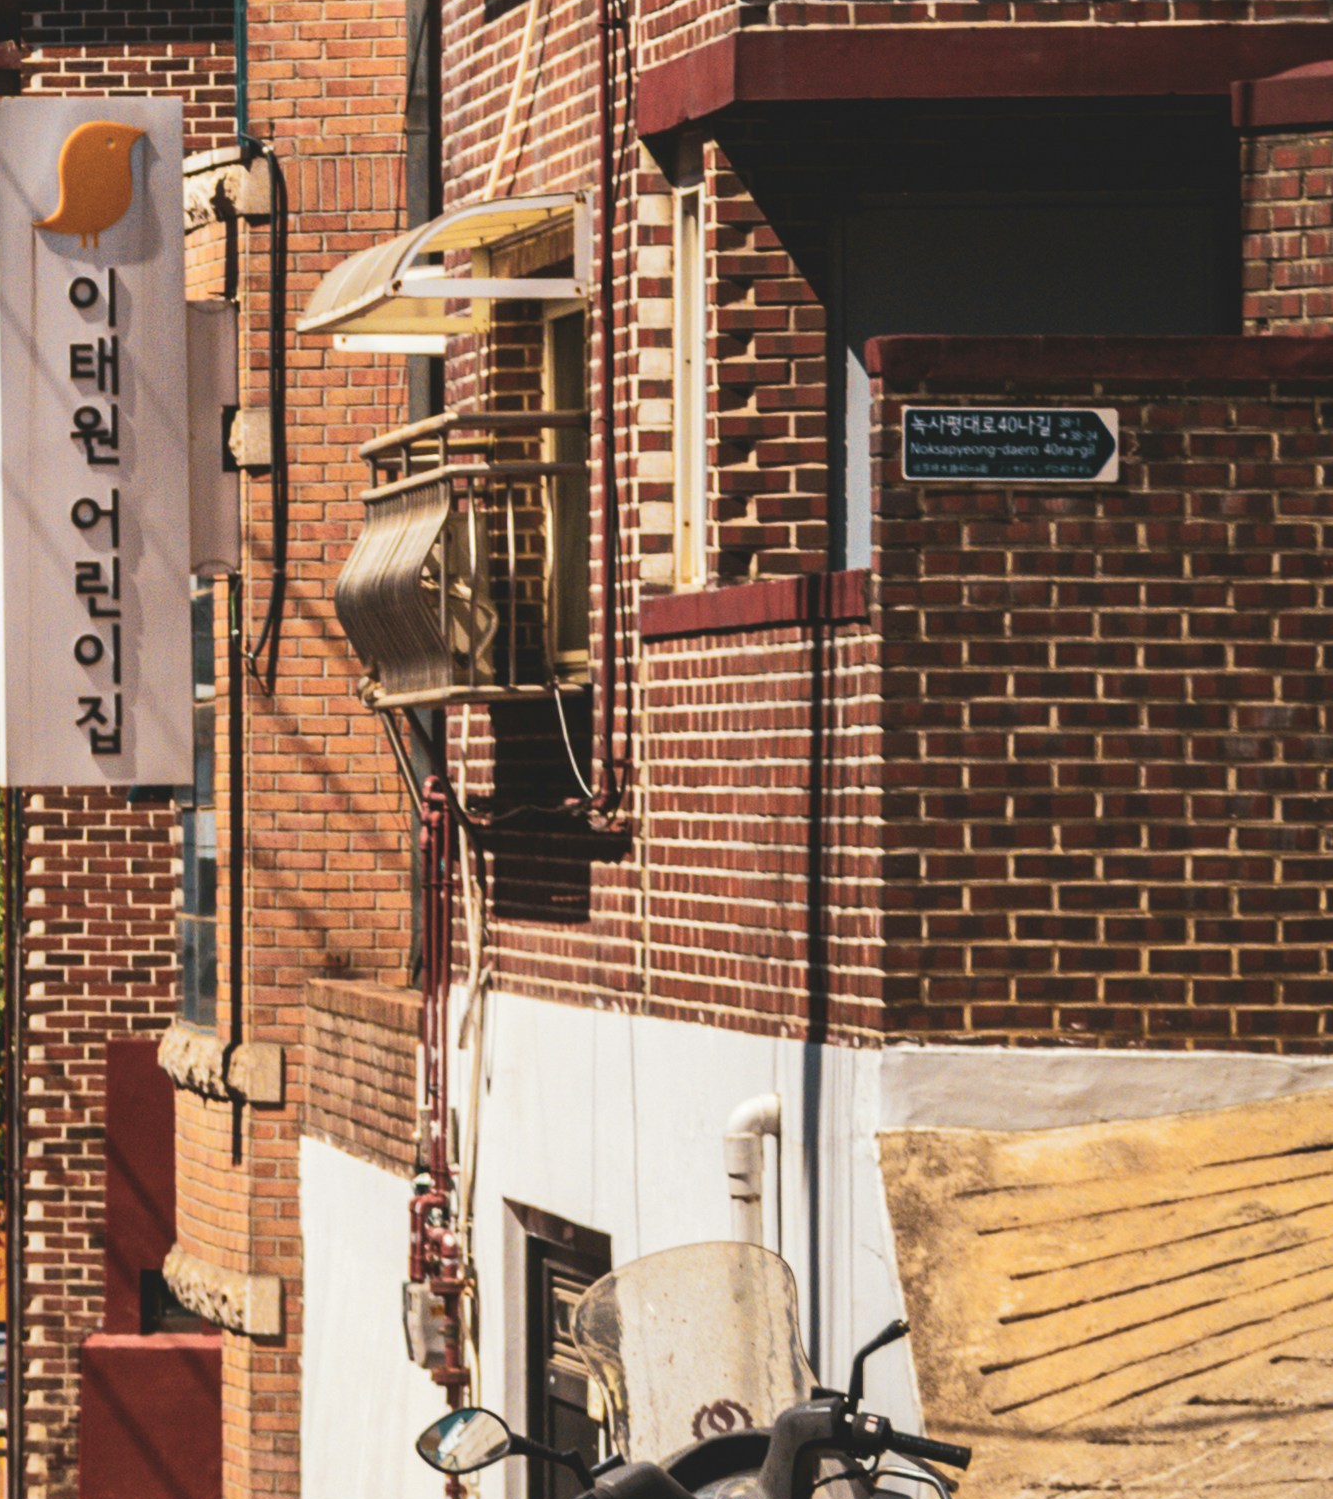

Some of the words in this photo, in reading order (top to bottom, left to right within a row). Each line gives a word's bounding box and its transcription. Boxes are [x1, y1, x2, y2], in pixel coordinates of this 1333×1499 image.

[68, 267, 120, 467] 이태원
[910, 442, 1040, 459] Noksapyeong-daero
[1042, 442, 1096, 459] 40na-gil
[911, 414, 1052, 438] 녹사평대로40나길
[70, 488, 122, 756] 어린이집
